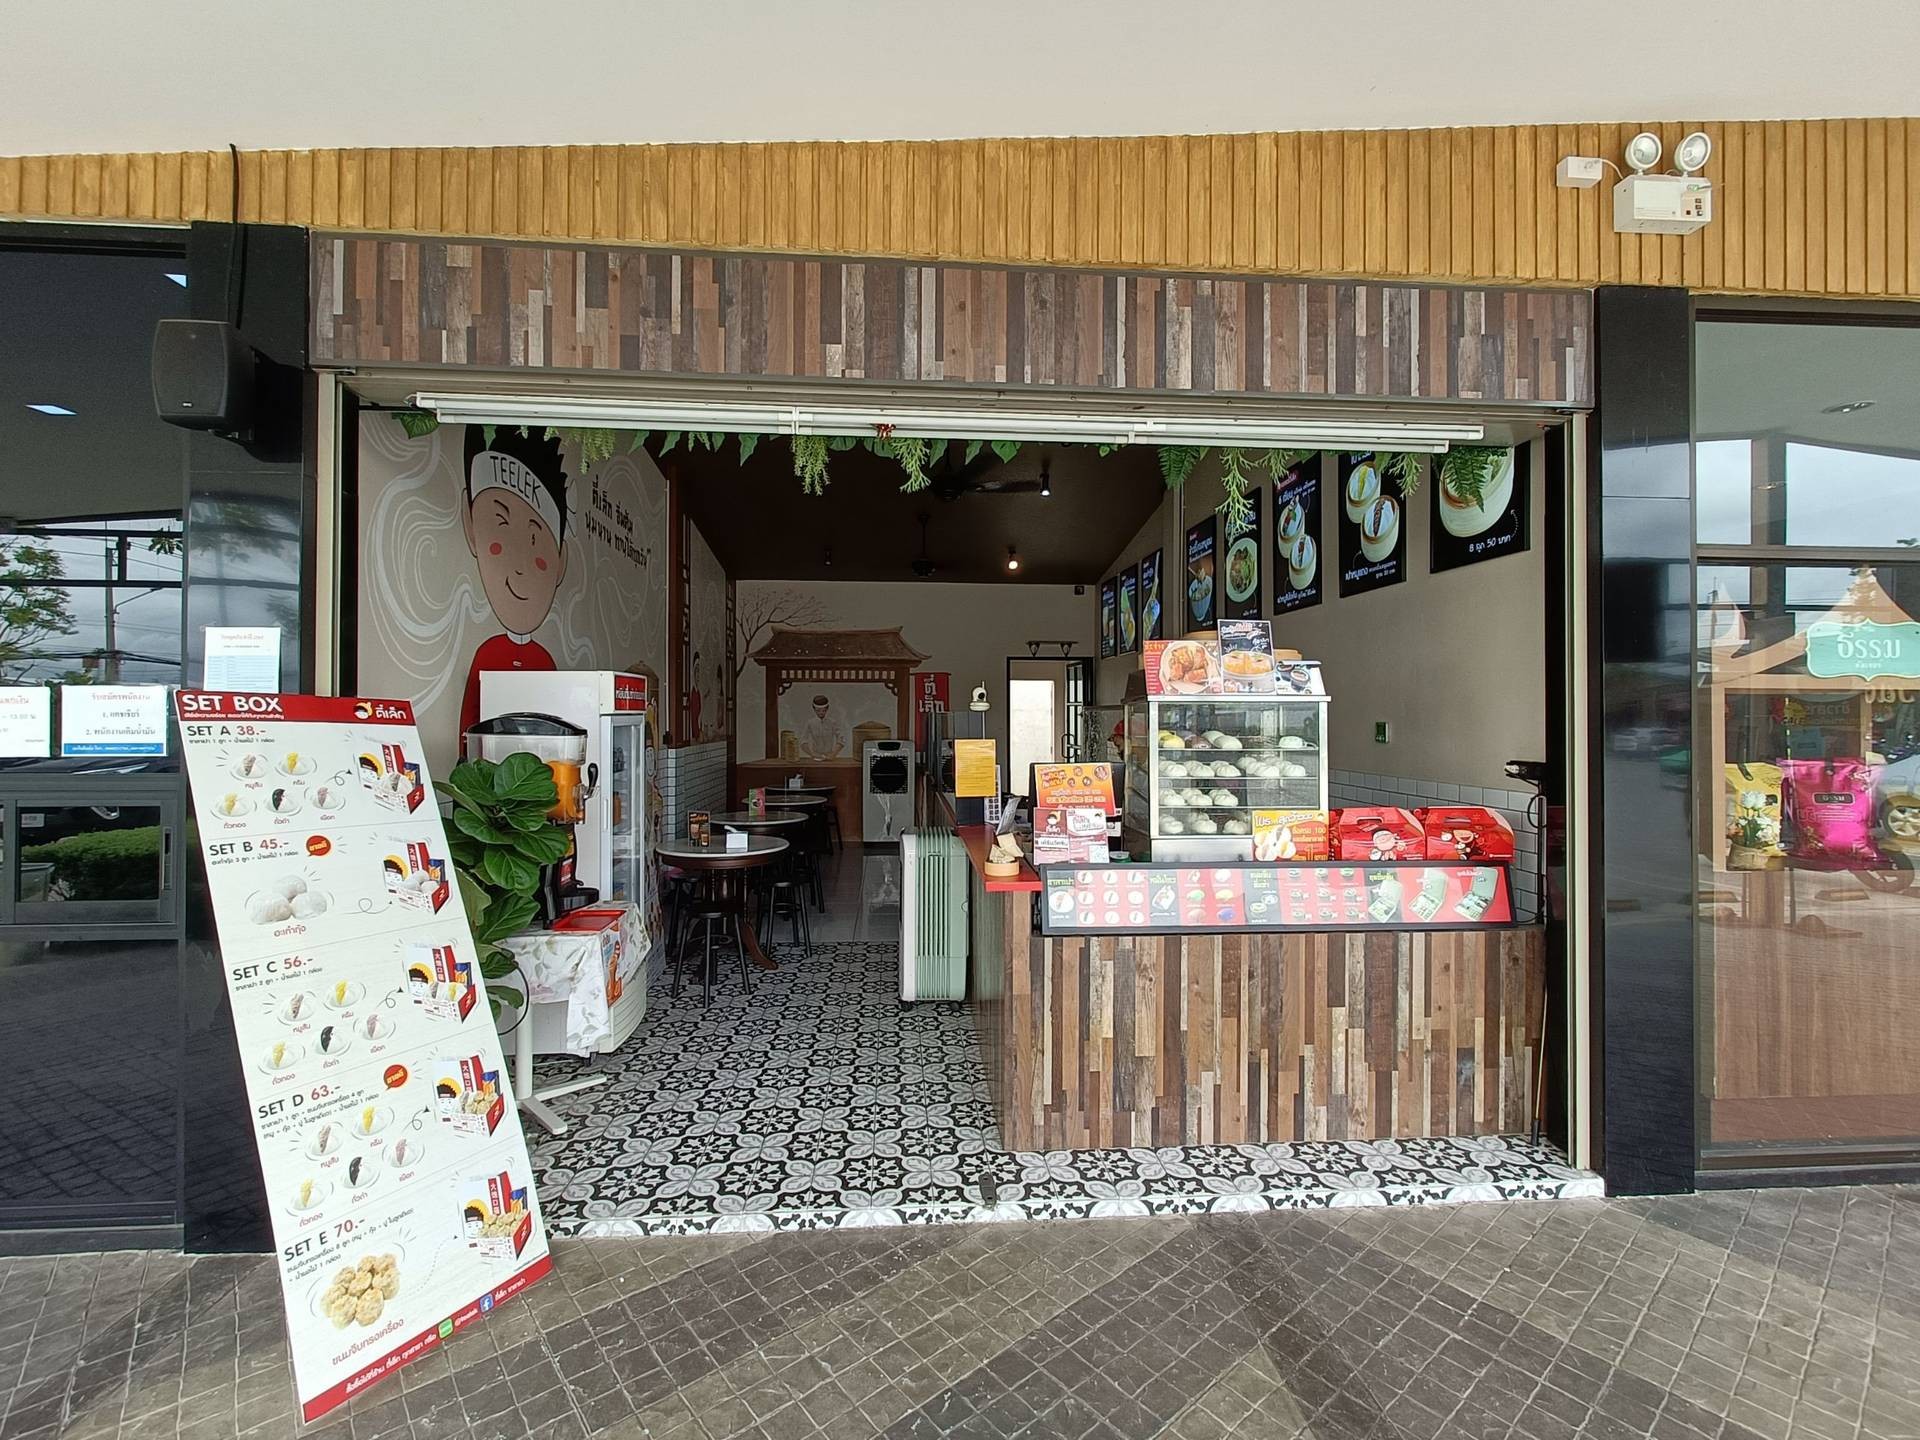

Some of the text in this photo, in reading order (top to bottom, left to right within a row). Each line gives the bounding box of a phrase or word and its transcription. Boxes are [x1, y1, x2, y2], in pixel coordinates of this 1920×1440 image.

[490, 456, 541, 509] TEELEK
[1487, 537, 1496, 548] 50
[1837, 631, 1901, 659] ธรรม
[182, 694, 283, 712] SET BOX
[187, 725, 266, 737] SET A 38.-
[209, 838, 289, 856] SET B 45.-
[232, 956, 314, 982] SET C 56.-
[258, 1084, 341, 1119] SET D 63.-
[283, 1218, 366, 1262] SET E 70.-
